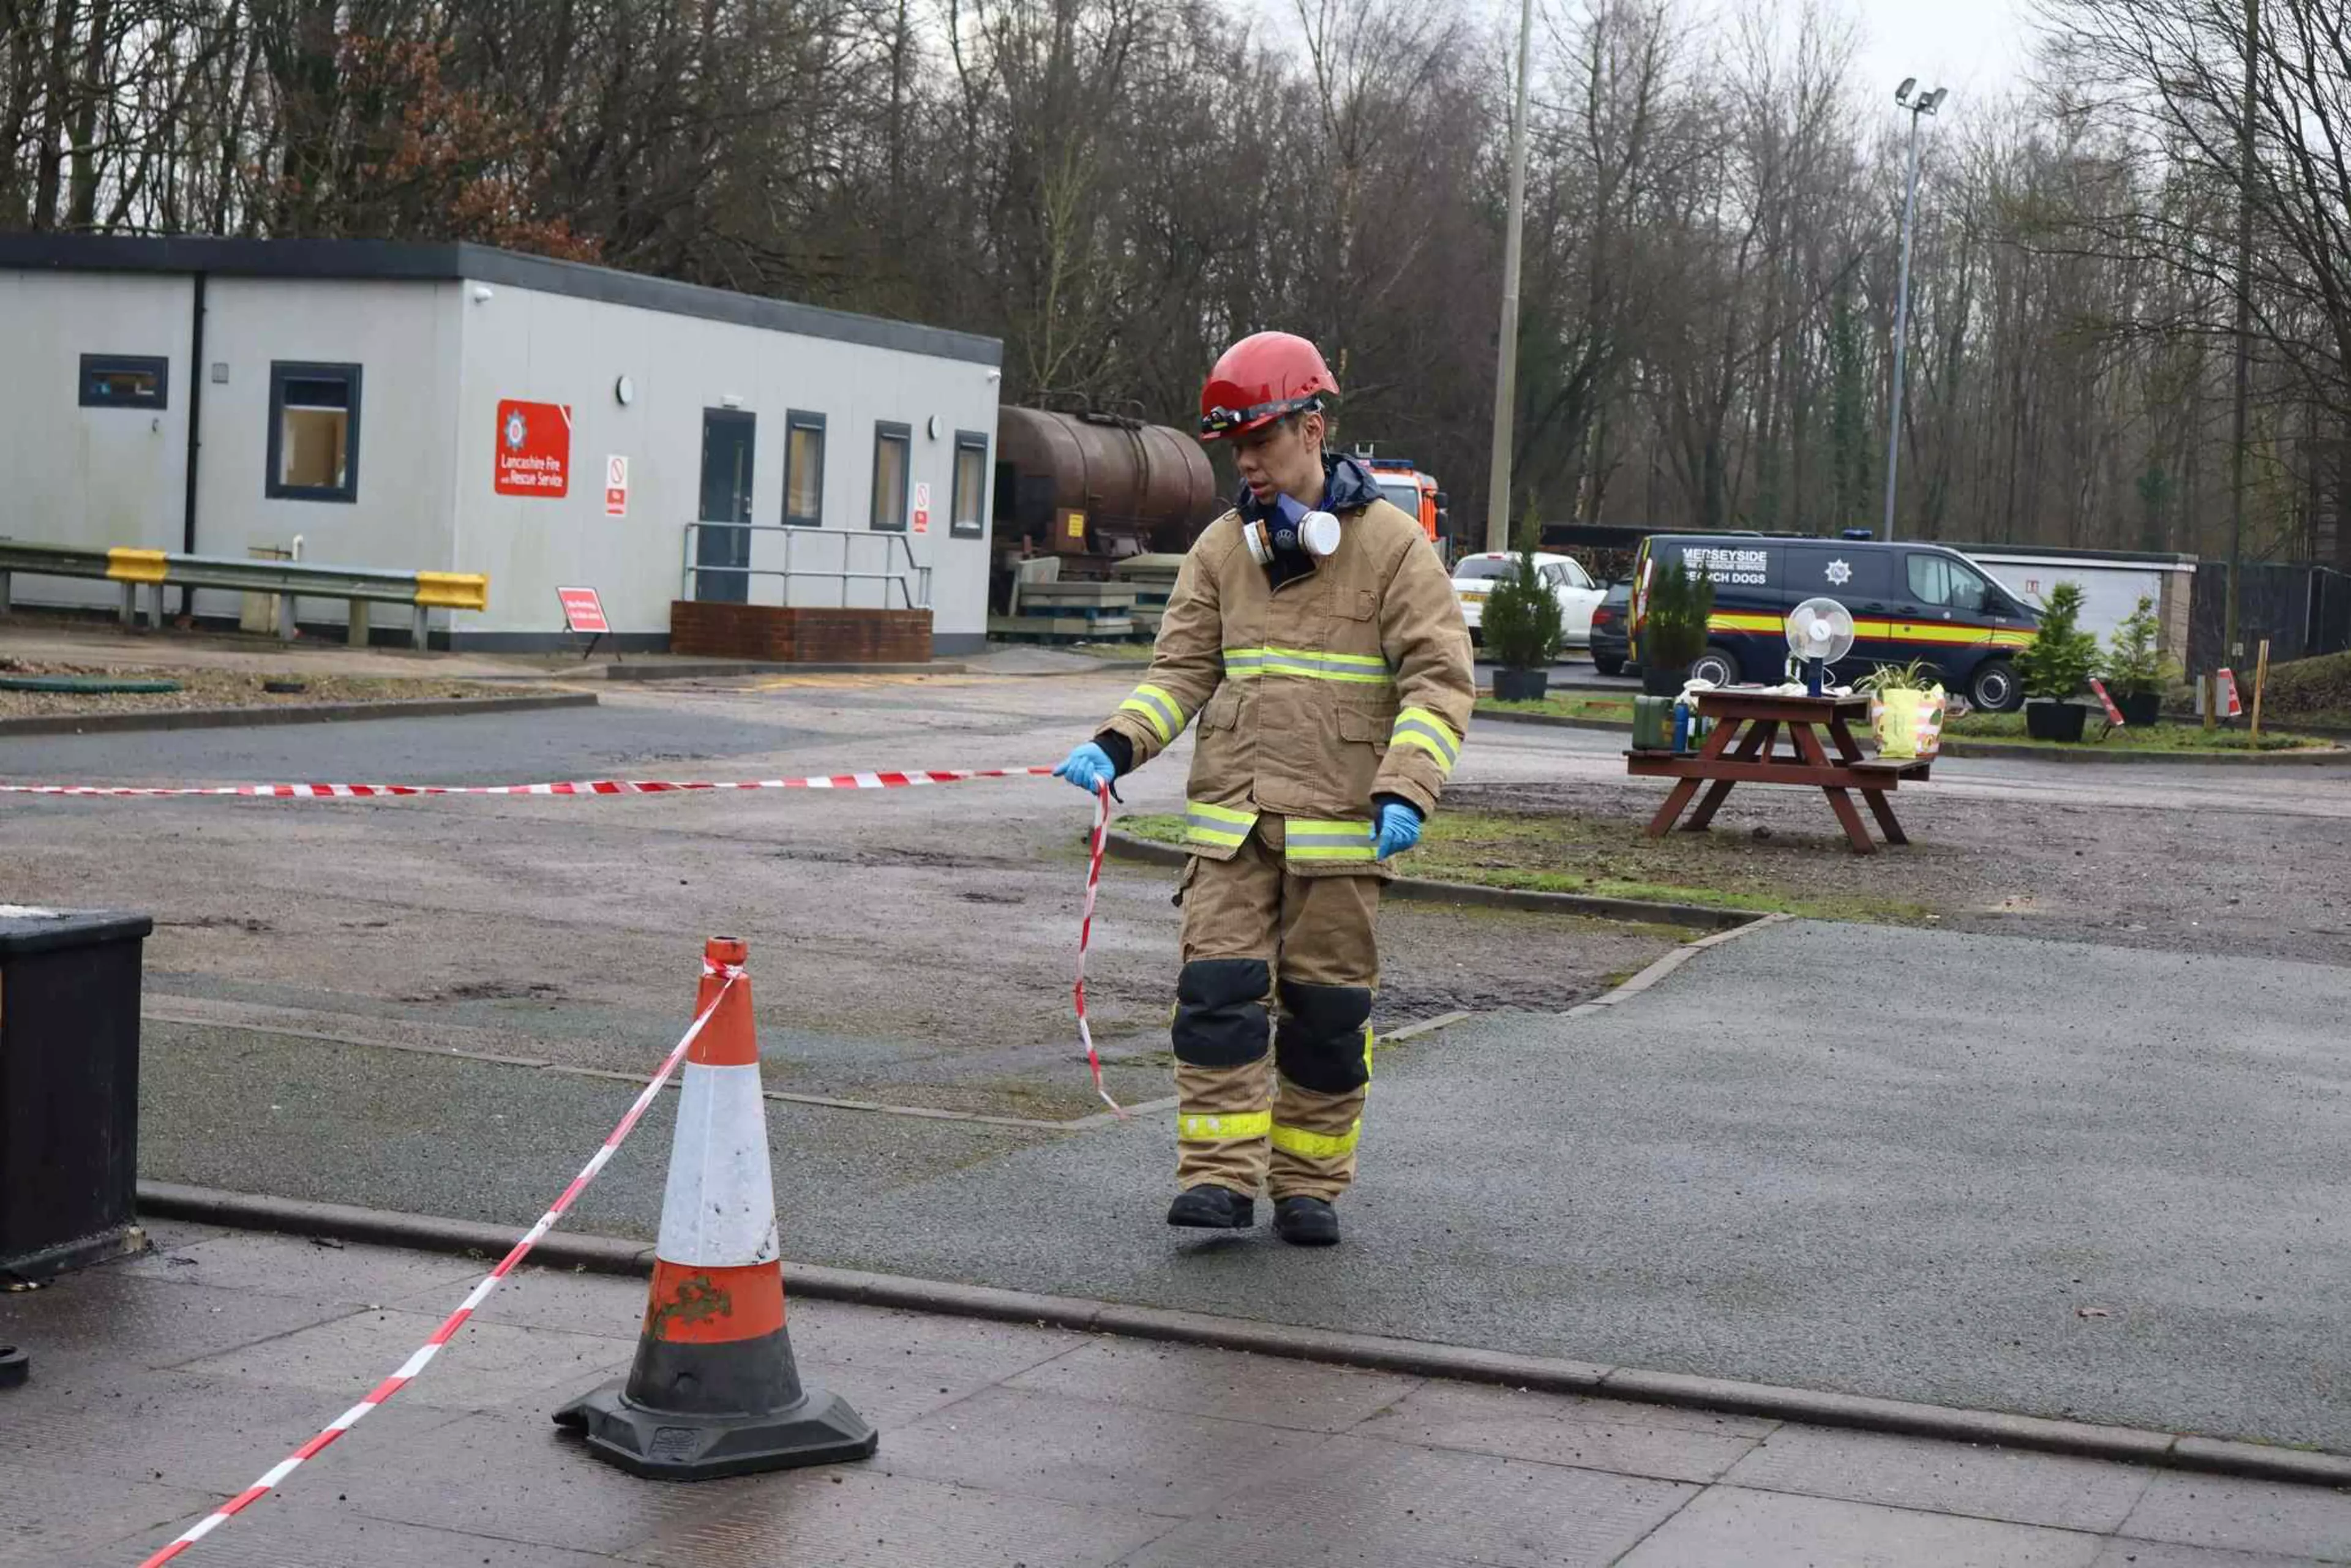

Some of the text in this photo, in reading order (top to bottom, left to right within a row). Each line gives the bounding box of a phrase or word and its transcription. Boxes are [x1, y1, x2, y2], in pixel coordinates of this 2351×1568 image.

[500, 452, 561, 471] Lancashire Fire
[511, 470, 536, 486] Rescue
[537, 471, 564, 487] Service
[1684, 571, 1766, 584] ERCH DOGS
